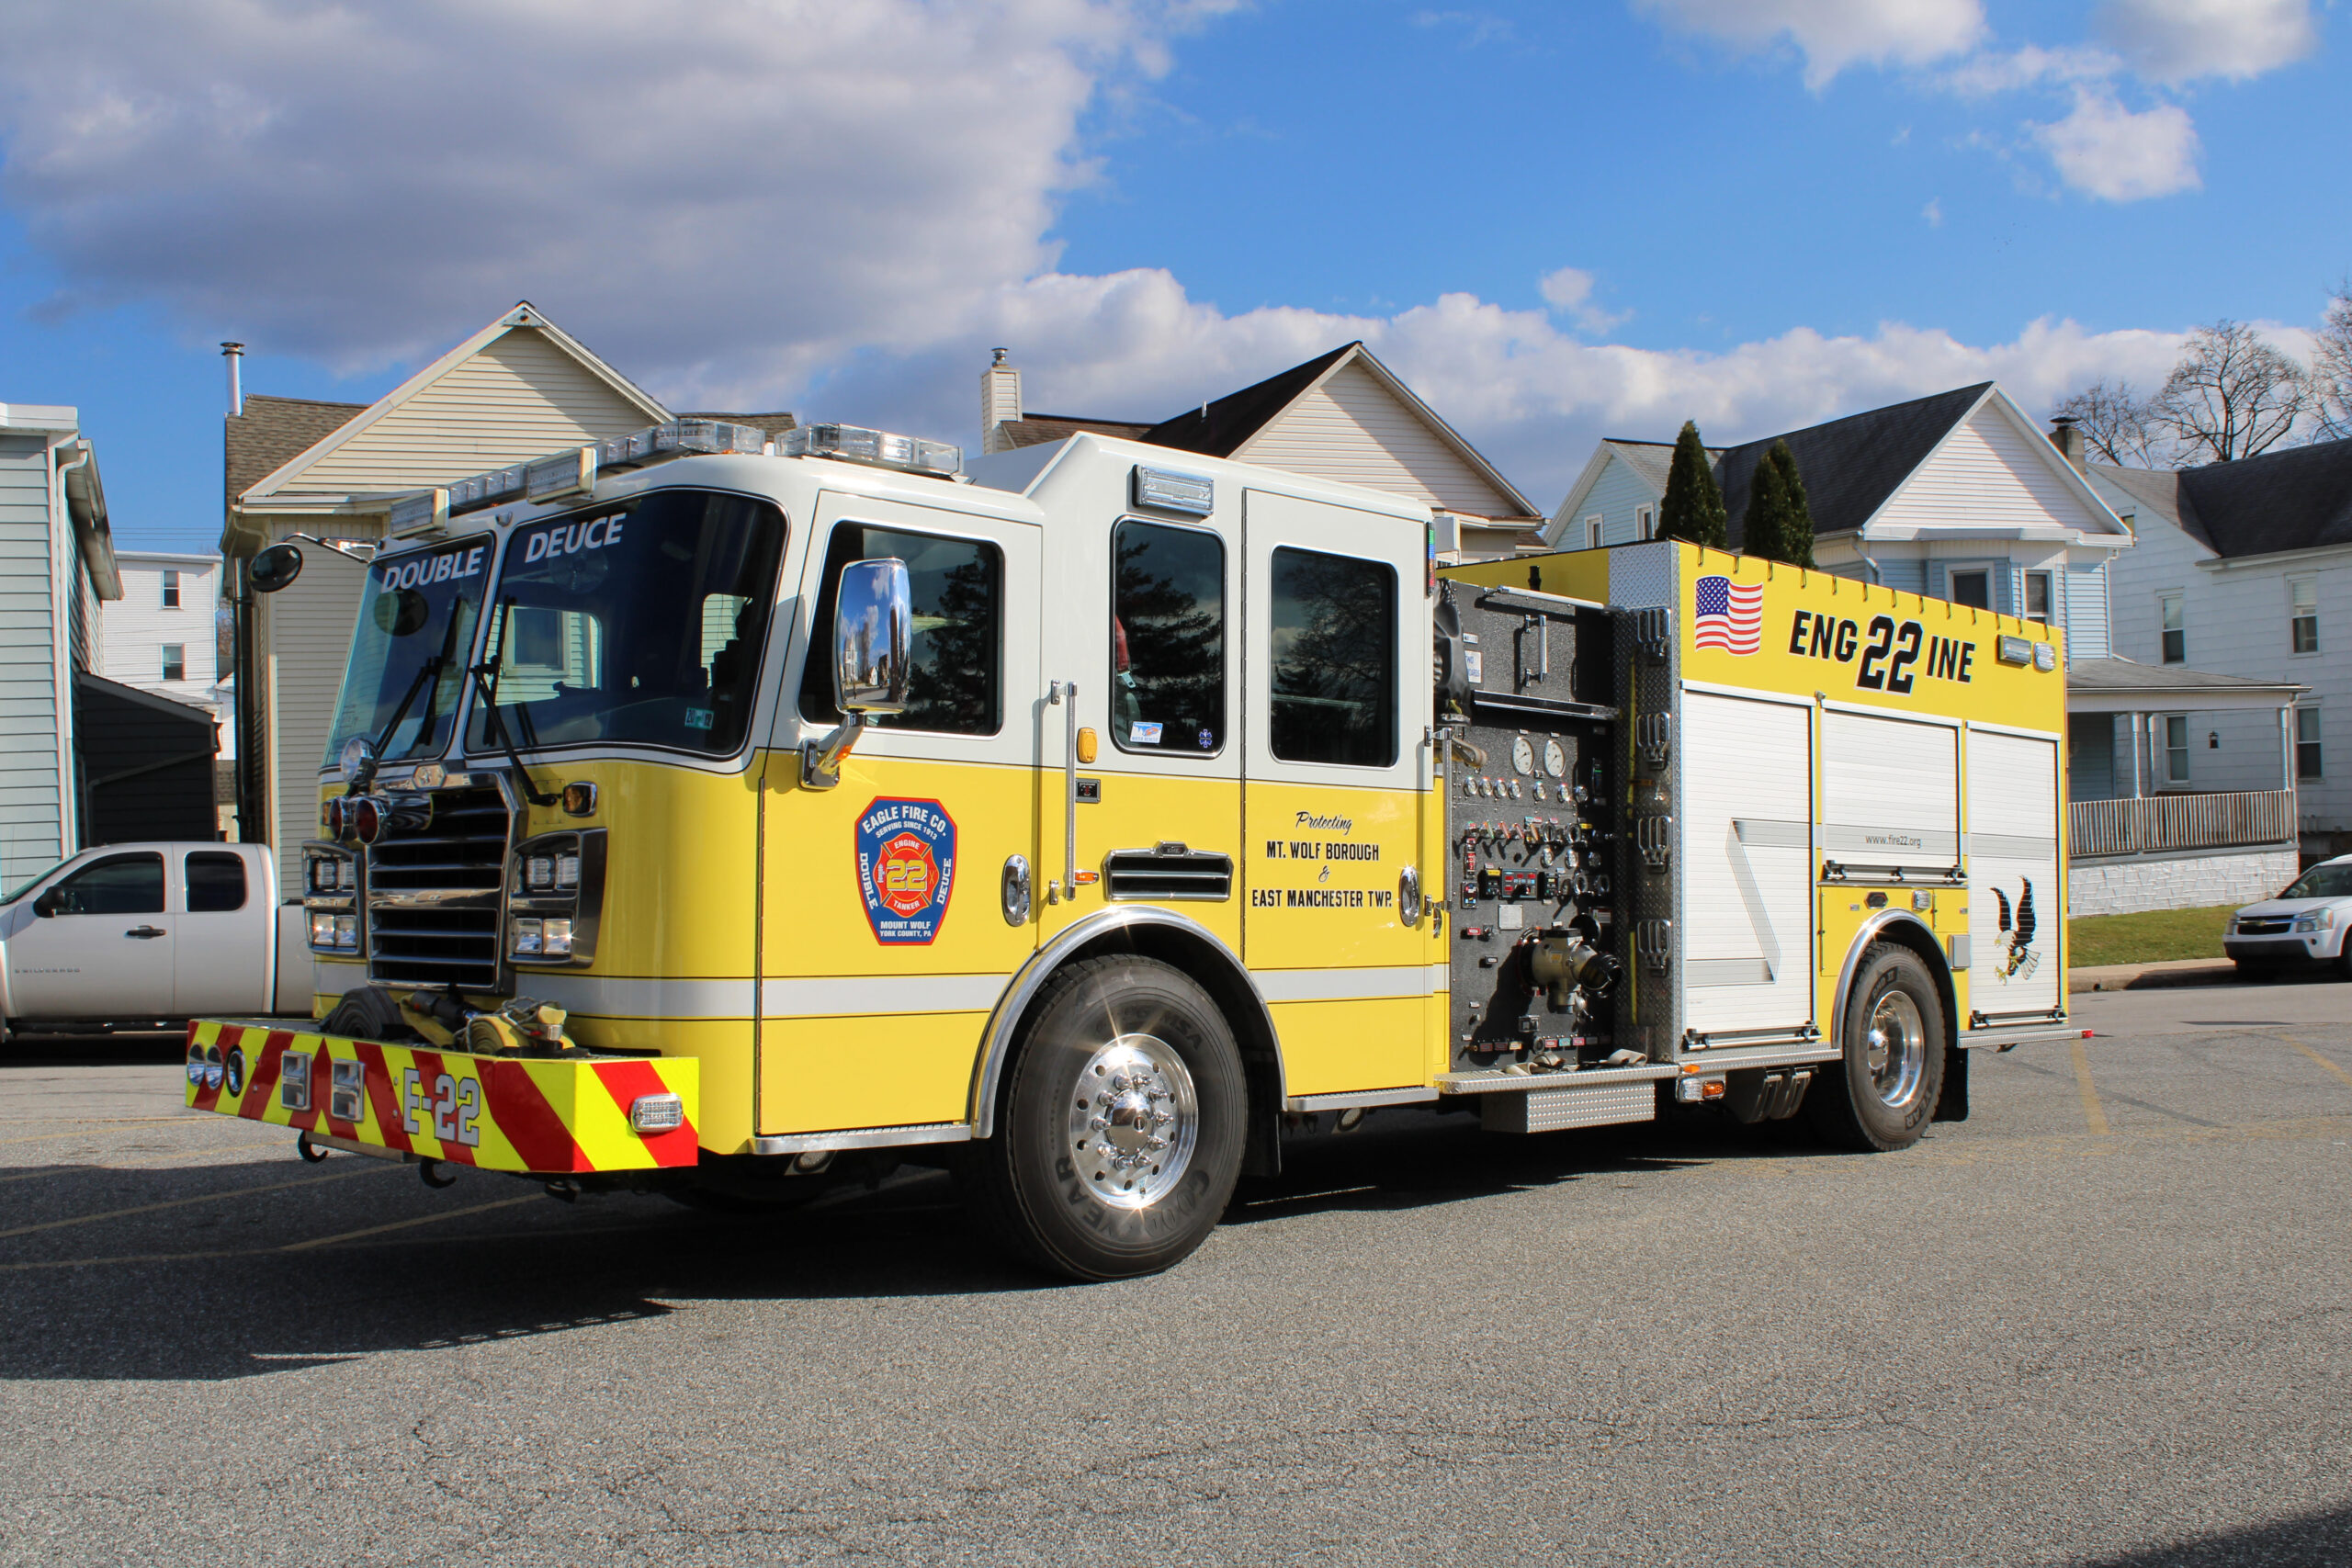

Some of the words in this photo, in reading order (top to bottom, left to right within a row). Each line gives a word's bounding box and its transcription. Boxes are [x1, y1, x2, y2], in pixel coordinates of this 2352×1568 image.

[380, 547, 485, 593] DOUBLE
[525, 513, 627, 563] DEUCE
[861, 805, 899, 834] EAGLE
[901, 805, 929, 823] FIRE
[930, 814, 947, 837] CO.
[875, 820, 903, 839] SERVING
[903, 820, 922, 831] SINCE
[922, 826, 938, 840] 1913
[1295, 811, 1352, 836] Protecting
[894, 839, 921, 851] ENGINE
[1266, 840, 1286, 859] MT.
[1290, 841, 1321, 859] WOLF
[1326, 842, 1379, 861] BOROUGH
[1864, 834, 1922, 849] www.fire22.org
[859, 852, 879, 909] DOUBLE
[886, 859, 928, 892] 22
[936, 858, 952, 905] DEUCE
[1317, 864, 1330, 883] &
[893, 900, 921, 910] TANKER
[1251, 889, 1283, 908] EAST
[1287, 889, 1363, 908] MANCHESTER
[1368, 890, 1392, 908] TWP.
[880, 920, 908, 930] MOUNT
[910, 920, 932, 930] WOLF
[897, 930, 922, 938] COUNTY,
[402, 1067, 481, 1148] E-22
